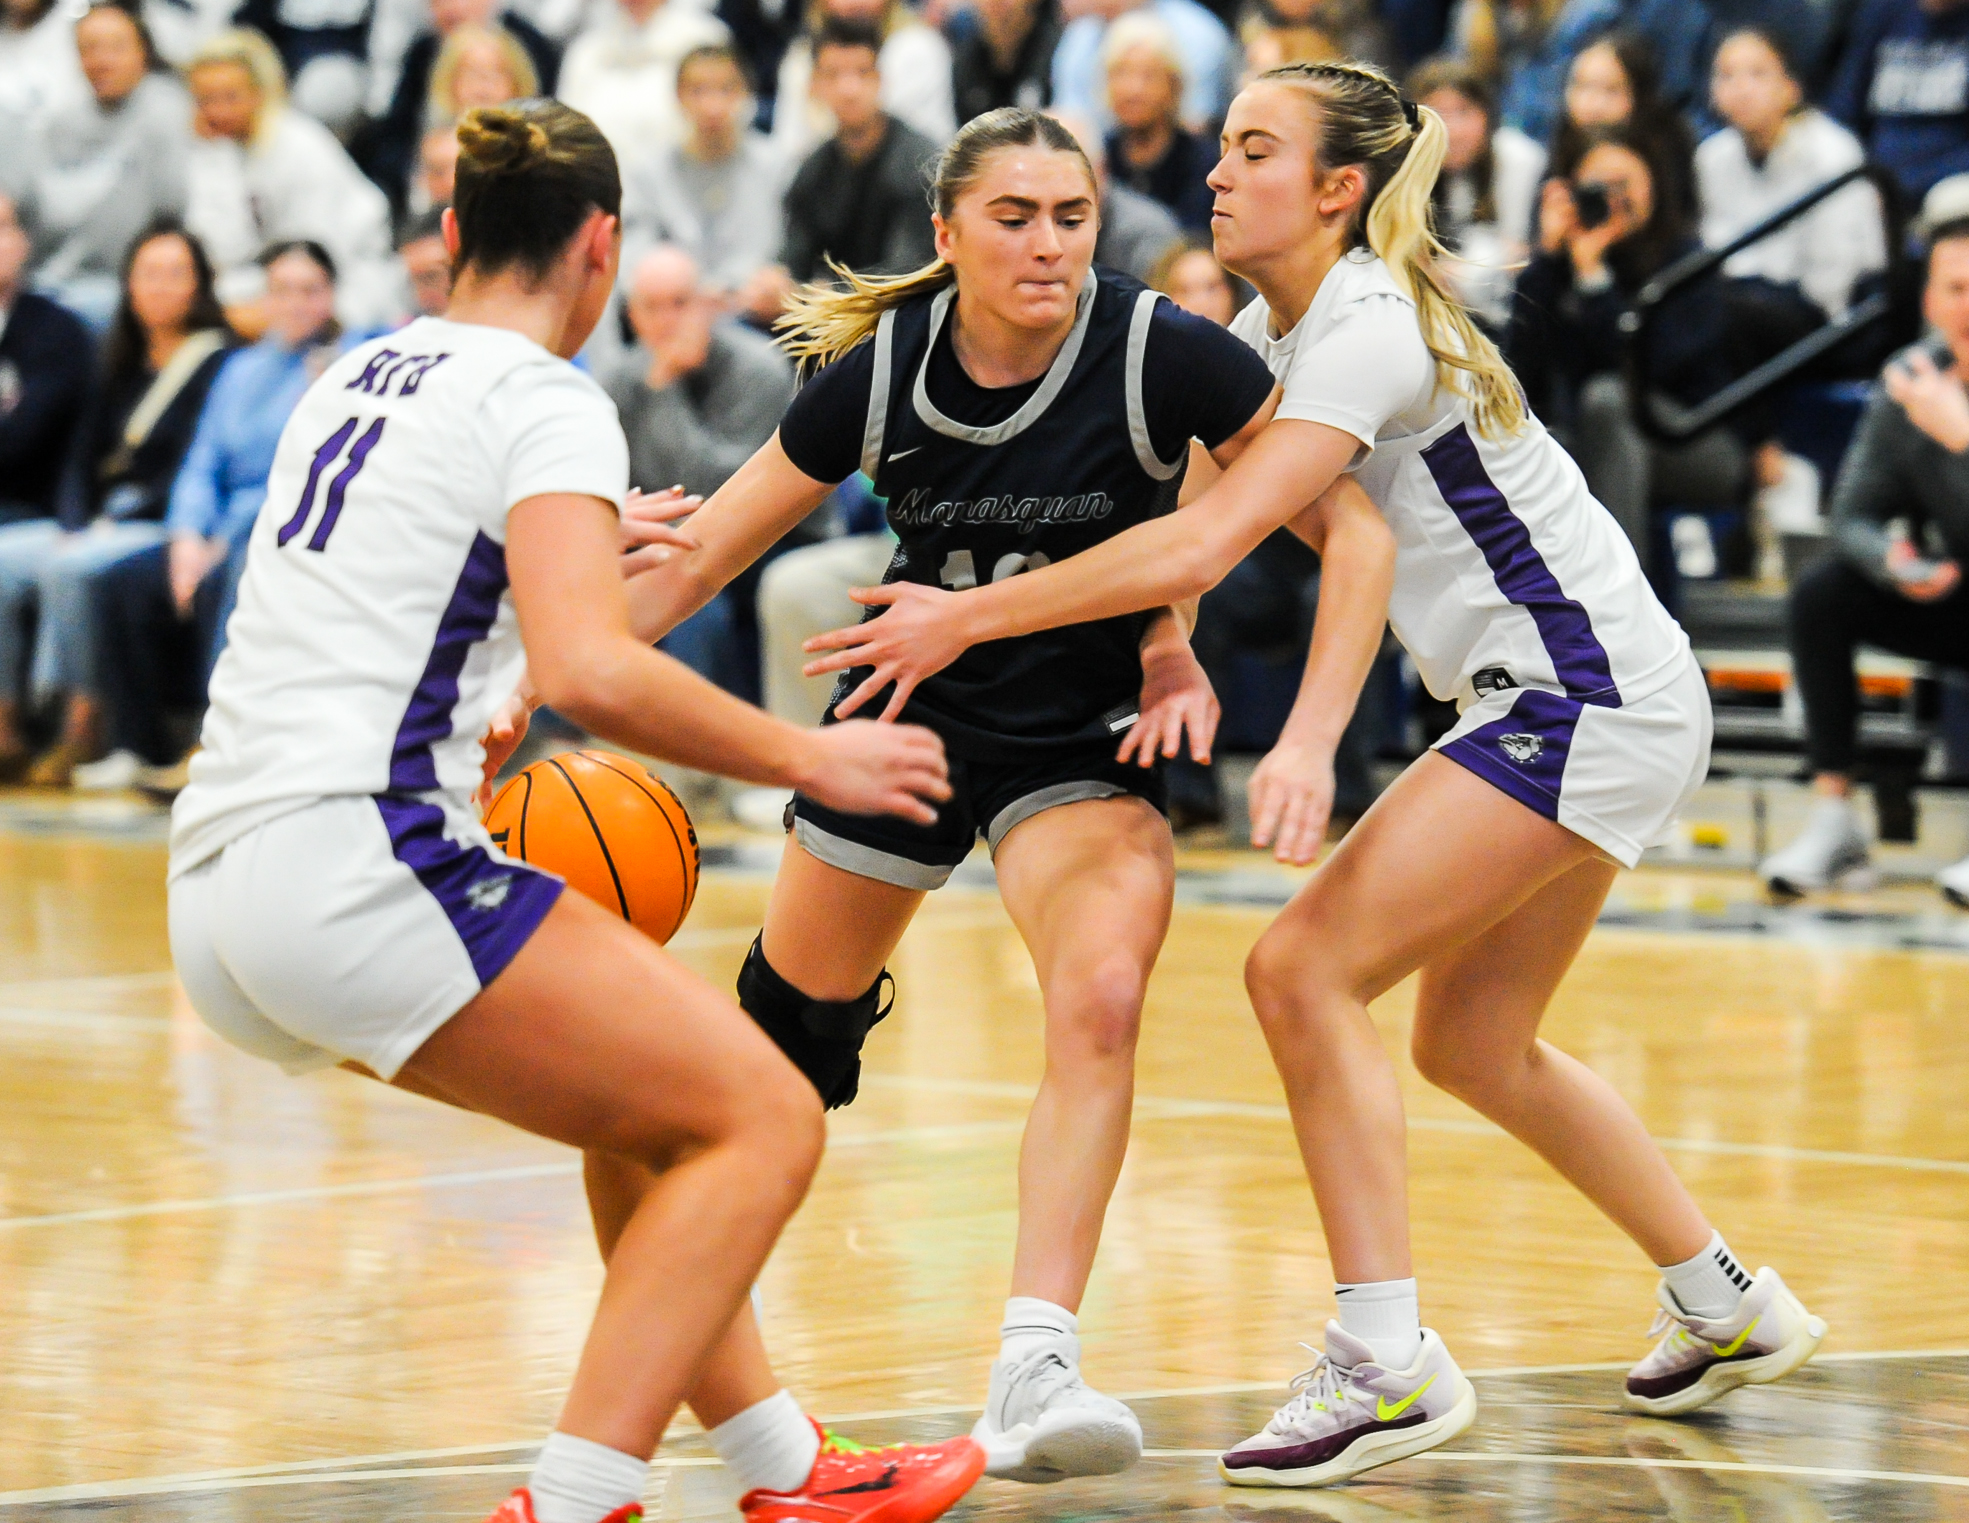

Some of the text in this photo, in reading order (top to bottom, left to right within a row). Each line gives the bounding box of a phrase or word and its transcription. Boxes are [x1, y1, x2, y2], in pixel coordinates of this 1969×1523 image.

[277, 416, 387, 552] 11
[892, 487, 1114, 534] Manasquan
[1496, 677, 1509, 688] M
